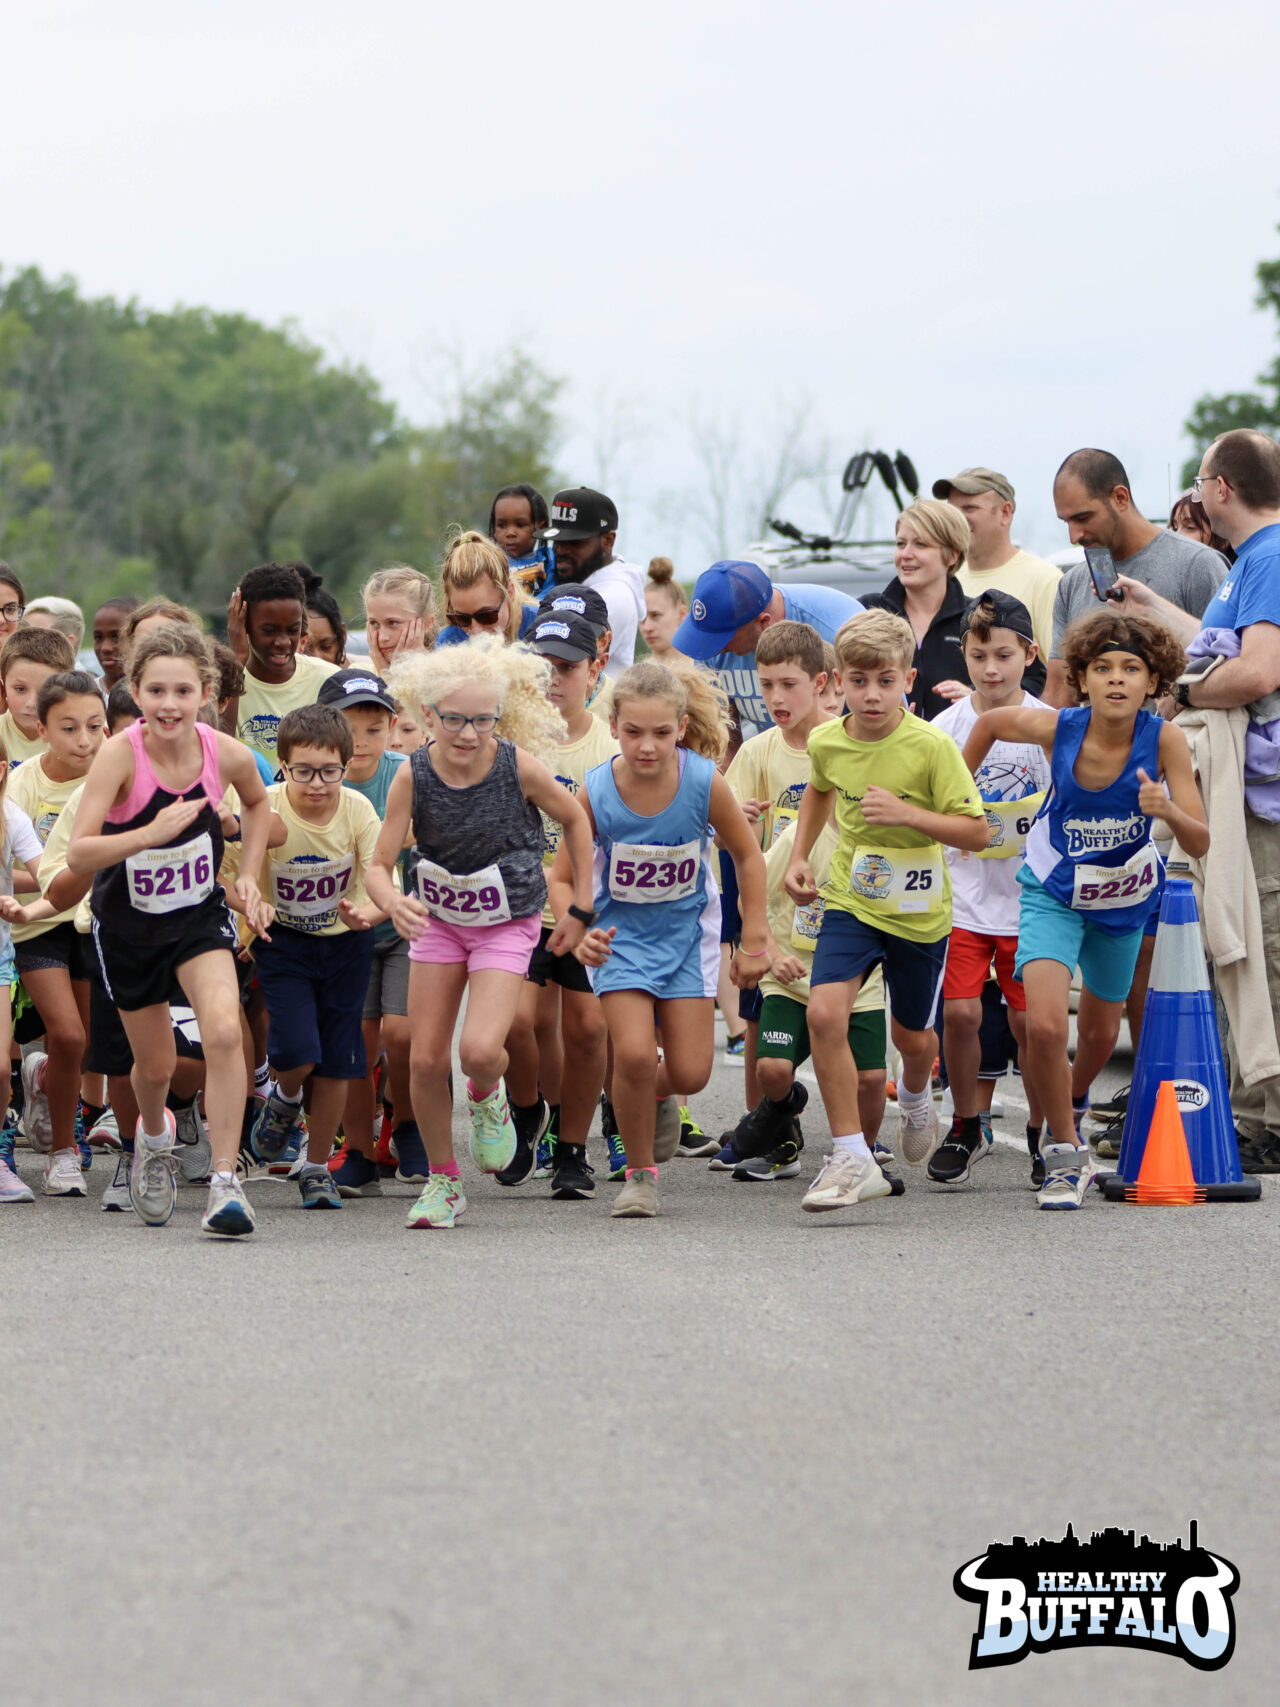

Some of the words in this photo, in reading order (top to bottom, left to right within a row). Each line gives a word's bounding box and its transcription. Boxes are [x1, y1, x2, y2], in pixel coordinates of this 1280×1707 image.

[1064, 816, 1146, 853] BUFFALO
[1083, 825, 1127, 835] HEALTHY
[134, 854, 210, 896] 5216
[276, 866, 352, 902] 5207
[615, 858, 696, 888] 5230
[904, 869, 932, 891] 25
[1080, 862, 1154, 901] 5224
[422, 877, 500, 912] 5229
[762, 1030, 794, 1044] NARDIN
